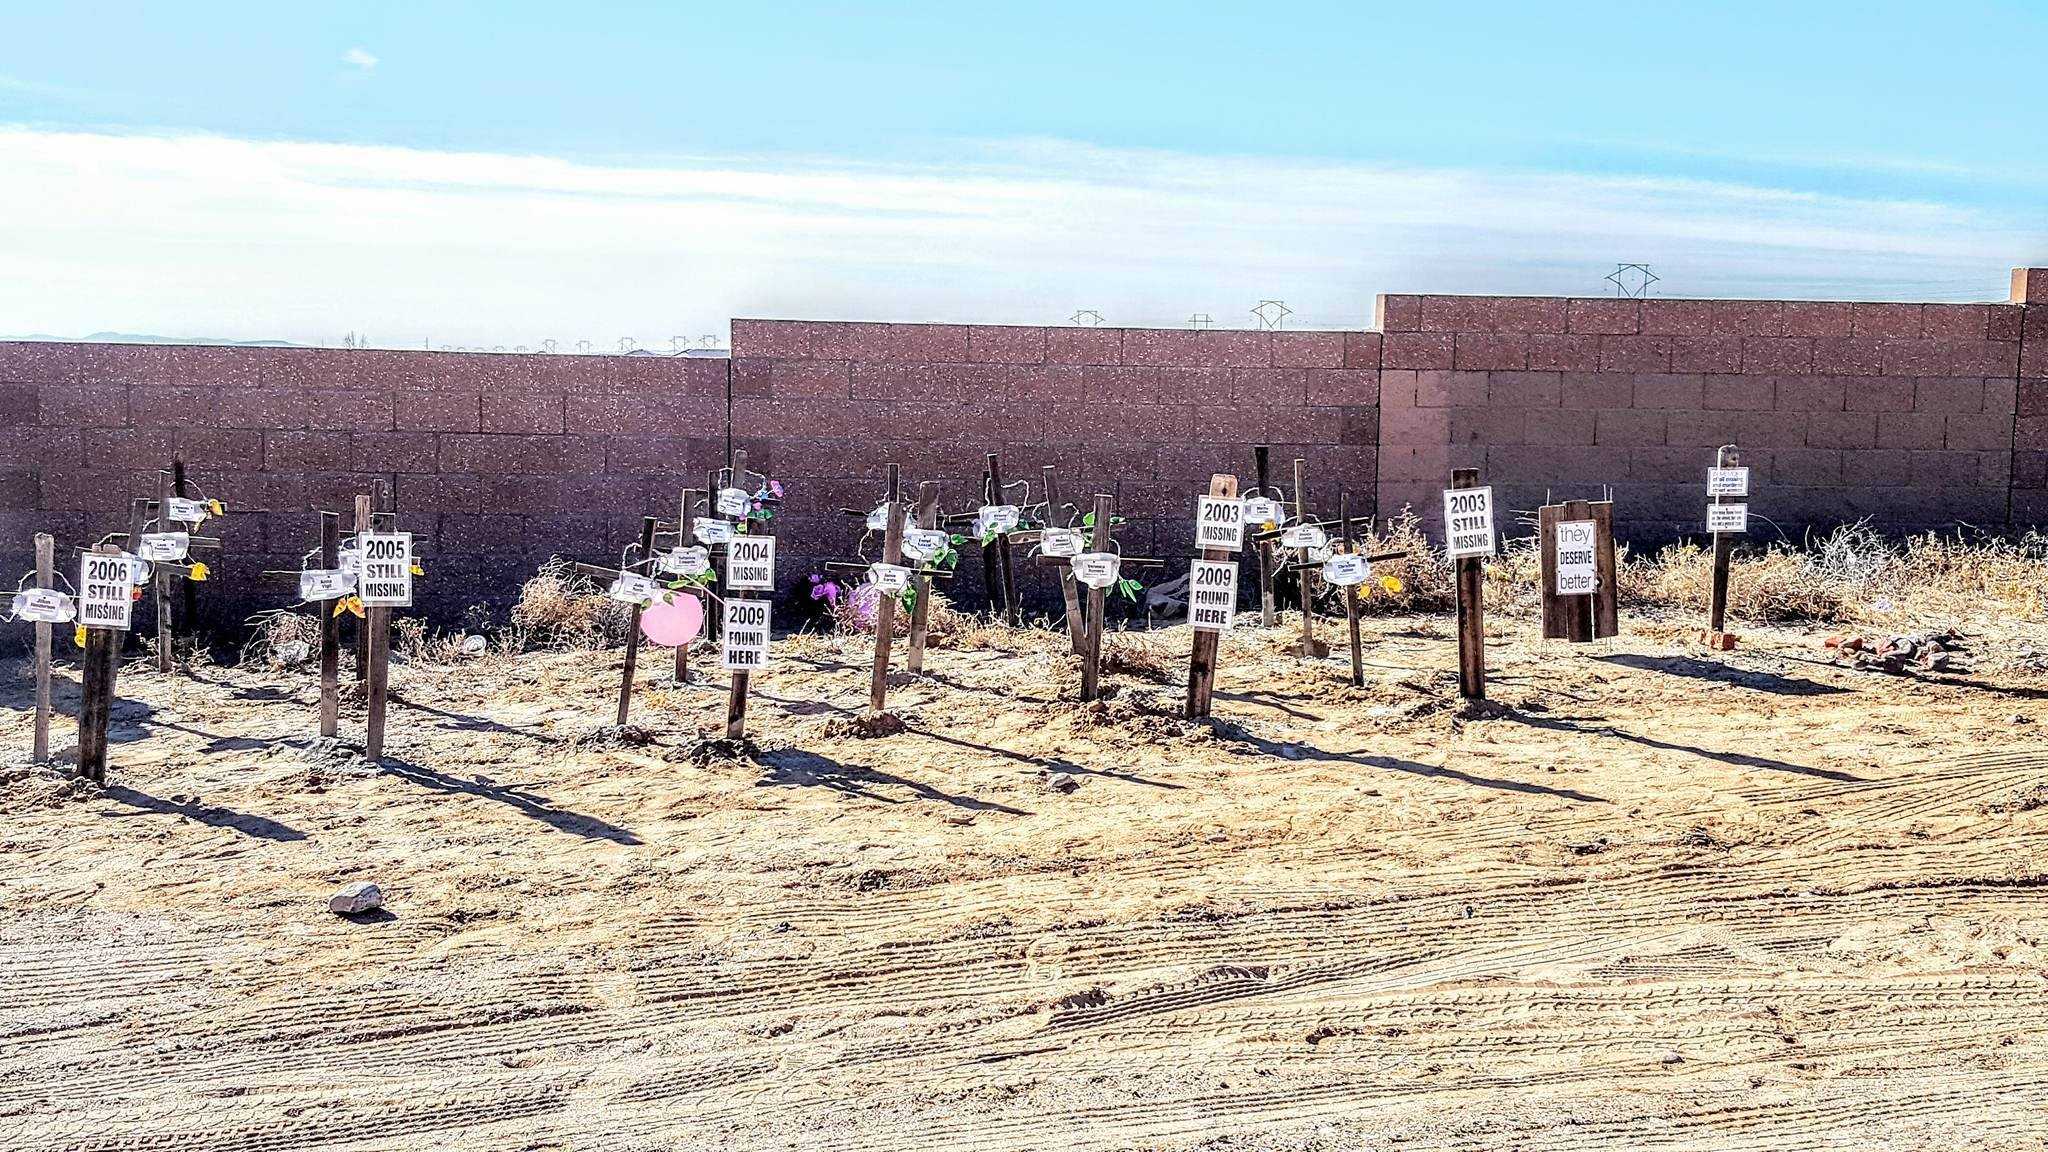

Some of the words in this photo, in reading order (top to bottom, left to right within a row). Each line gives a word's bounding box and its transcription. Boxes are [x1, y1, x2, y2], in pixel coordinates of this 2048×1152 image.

[1450, 494, 1486, 514] 2003
[1204, 503, 1239, 523] 2003
[1452, 516, 1487, 532] STILL
[1202, 525, 1238, 542] MISSING
[1453, 533, 1488, 550] MISSING
[1560, 526, 1590, 544] they
[366, 540, 405, 560] 2005
[734, 542, 768, 562] 2004
[1560, 550, 1592, 564] DESERVE
[88, 560, 127, 582] 2006
[366, 564, 404, 578] STILL
[733, 566, 768, 581] MISSING
[1196, 567, 1232, 586] 2009
[366, 582, 405, 597] MISSING
[1560, 574, 1592, 590] better
[88, 584, 125, 601] STILL
[1196, 590, 1230, 606] FOUND
[86, 604, 124, 620] MISSING
[730, 606, 765, 626] 2009
[1195, 608, 1227, 624] HERE
[728, 631, 763, 646] FOUND
[728, 650, 760, 664] HERE
